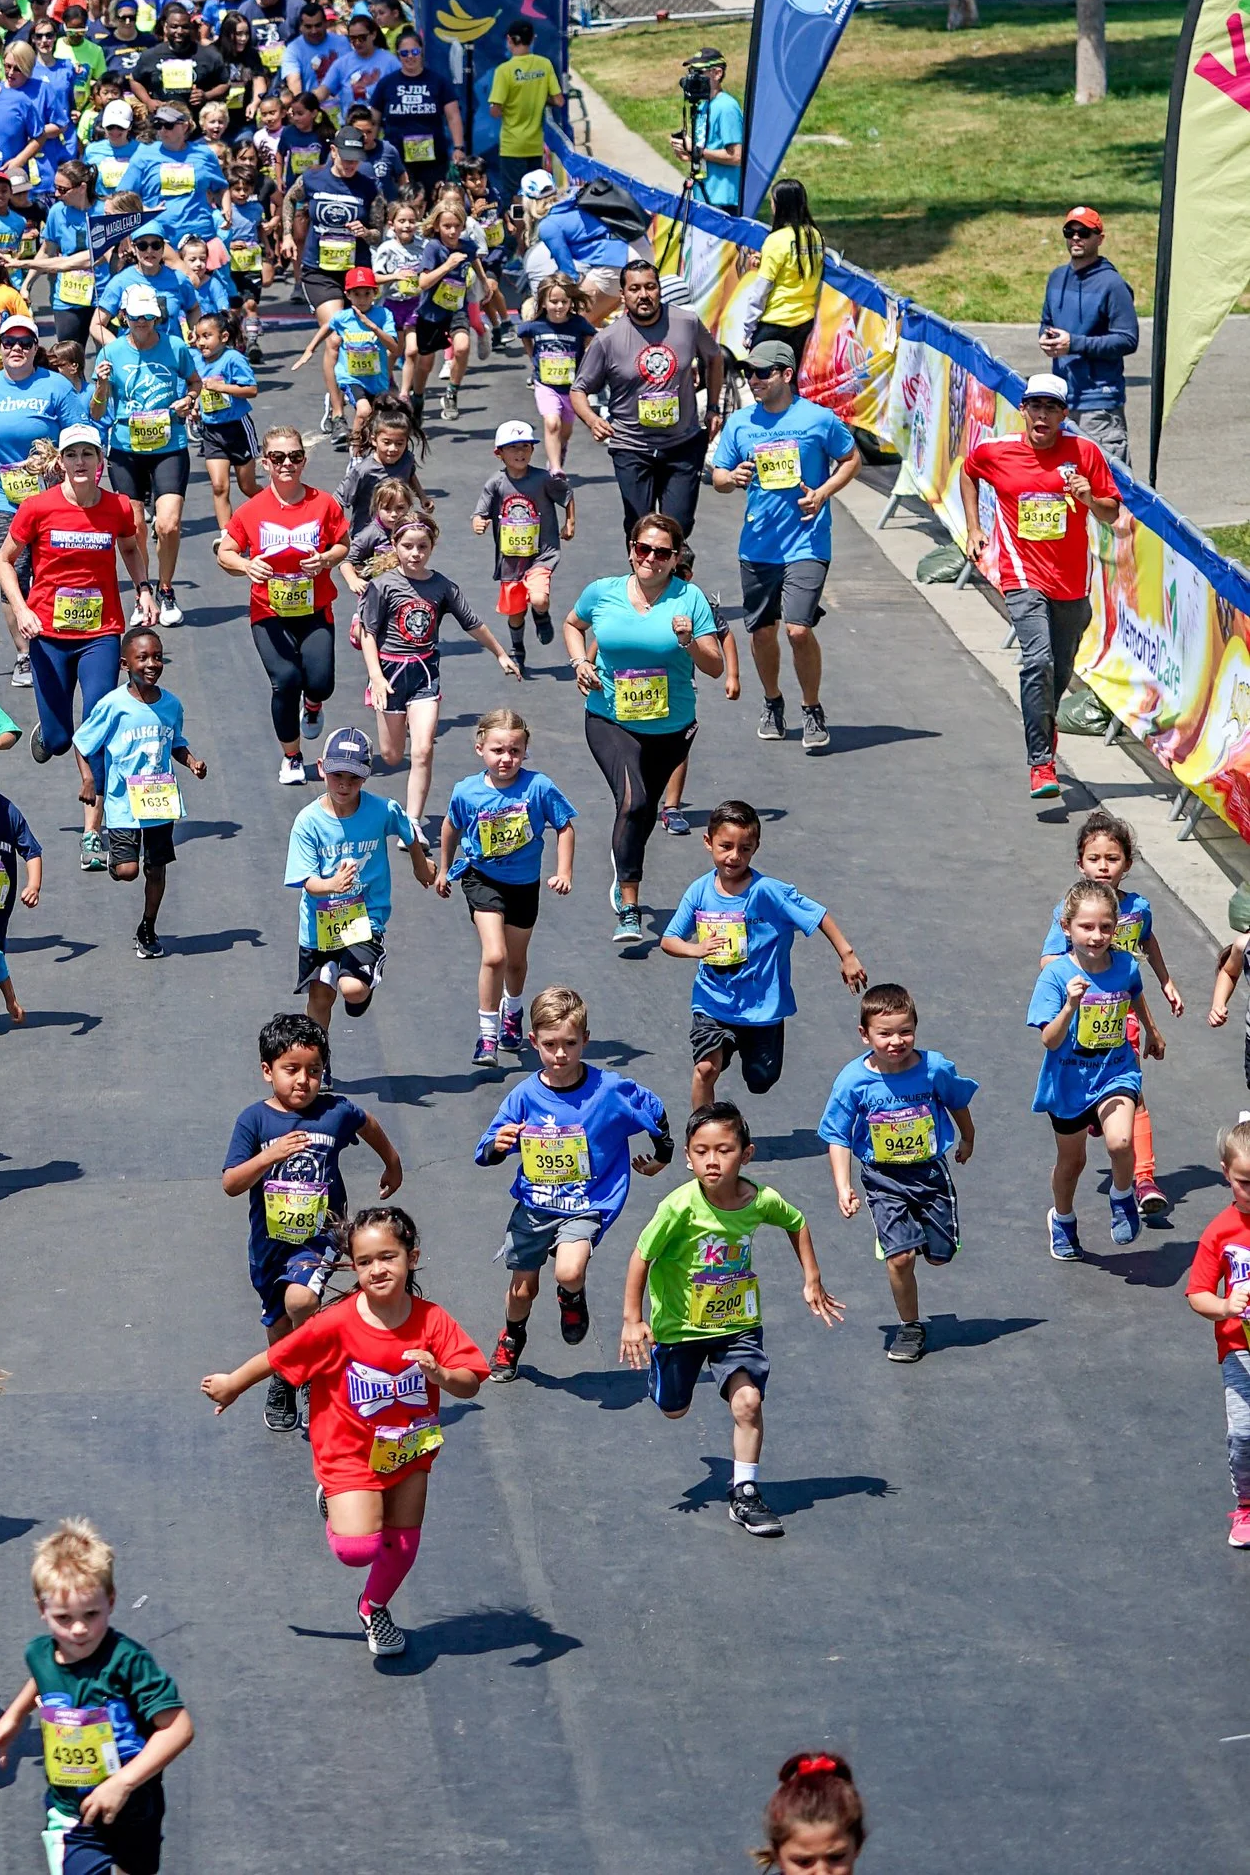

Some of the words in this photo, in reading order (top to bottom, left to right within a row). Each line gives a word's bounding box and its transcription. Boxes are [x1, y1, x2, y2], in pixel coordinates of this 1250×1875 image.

[396, 85, 431, 96] SJDL
[388, 104, 438, 115] LANCERS
[105, 212, 142, 237] MARBLEHEAD
[63, 280, 89, 292] 9311C
[351, 360, 372, 369] 2151
[134, 426, 166, 438] 5050C
[762, 460, 795, 473] 9310C
[7, 478, 39, 492] 1615C
[1023, 512, 1061, 525] 9313C
[65, 543, 100, 551] ELEMENTARY
[507, 536, 534, 547] 6552
[273, 590, 308, 601] 3785C
[63, 609, 100, 620] 9940C
[1117, 601, 1181, 698] MemorialCare
[140, 796, 170, 807] 1635
[490, 829, 523, 845] 9324
[1091, 1018, 1124, 1033] 9378
[884, 1135, 925, 1151] 9424
[535, 1154, 575, 1169] 3953
[531, 1193, 590, 1211] SPRINTERS
[278, 1211, 316, 1228] 2783
[703, 1243, 750, 1267] KIDS
[705, 1294, 742, 1313] 5200
[350, 1371, 392, 1405] HOPE
[398, 1373, 428, 1397] VIE
[53, 1747, 99, 1765] 4393
